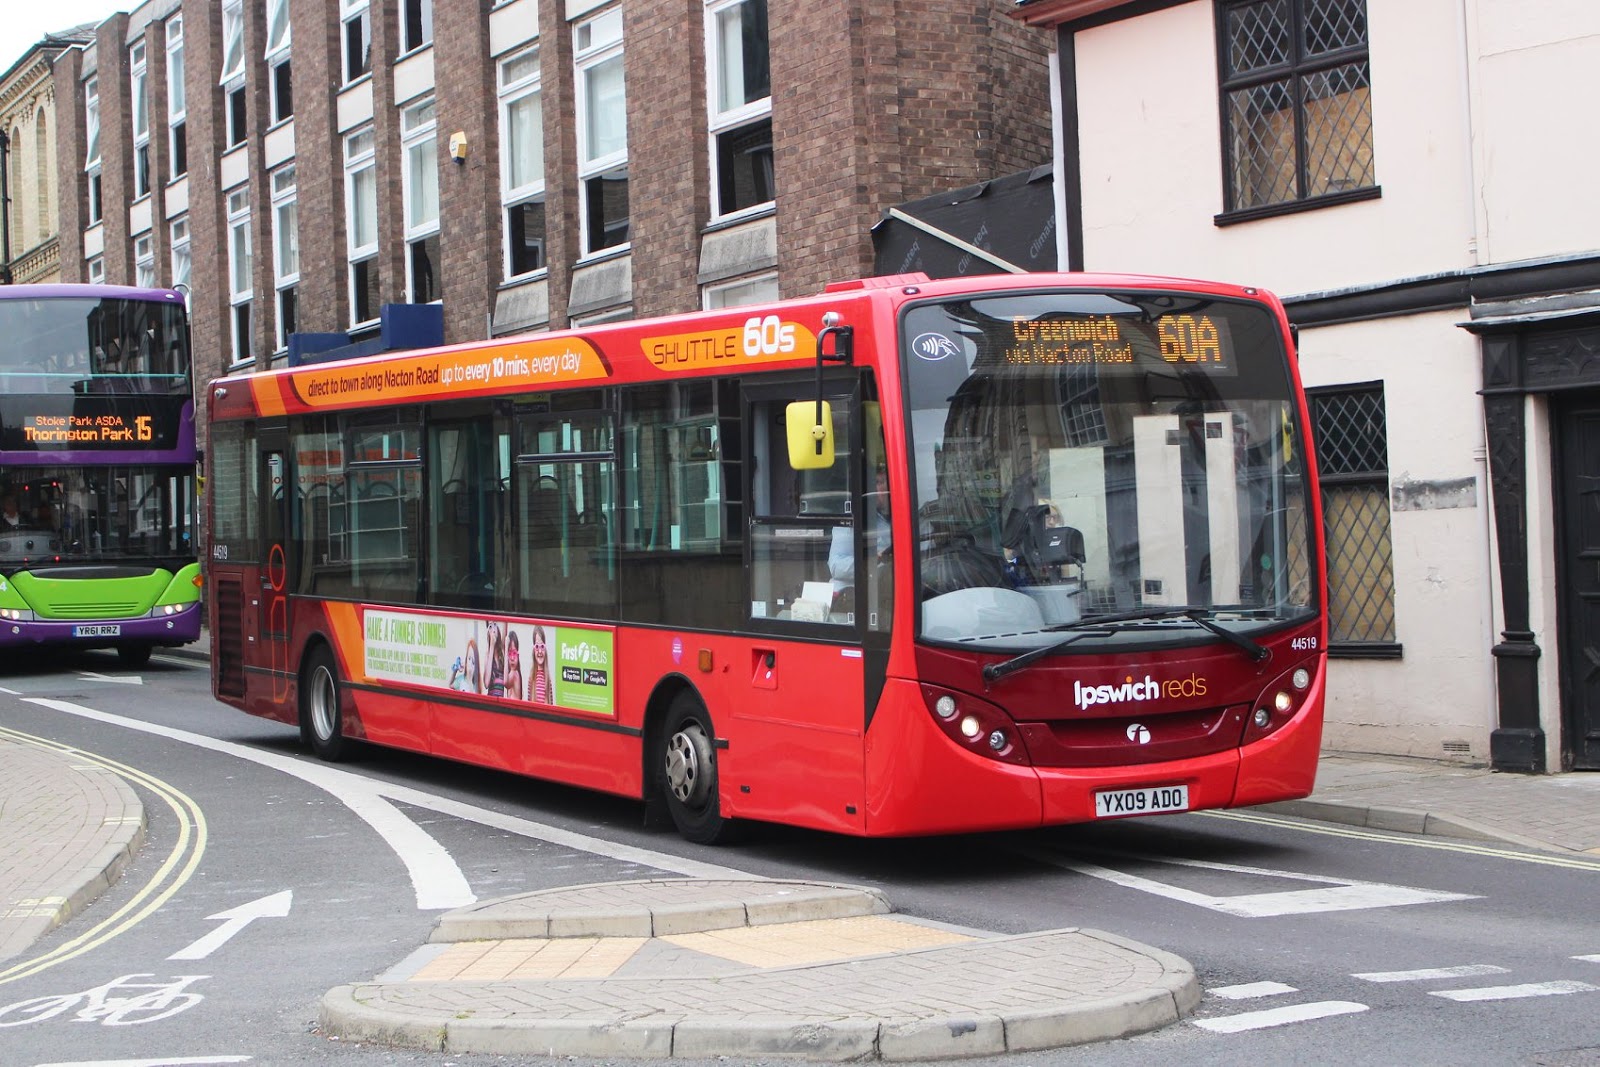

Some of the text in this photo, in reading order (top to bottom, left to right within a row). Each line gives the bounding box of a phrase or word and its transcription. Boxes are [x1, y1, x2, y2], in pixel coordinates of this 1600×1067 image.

[653, 314, 795, 364] SHUTTLE 60s
[1013, 315, 1221, 362] Greenwich 60A
[1005, 343, 1030, 363] via
[1092, 343, 1132, 362] Road
[308, 348, 582, 397] direct to town along Nacton Road up to every 10 mins, every day
[36, 416, 123, 426] Stoke Park ASDA
[135, 416, 152, 440] 15
[24, 427, 134, 441] Thorington Park
[79, 626, 118, 635] YR61 RRZ
[384, 618, 389, 641] A
[561, 642, 608, 664] First Bus
[1292, 637, 1317, 650] 44519
[1074, 673, 1207, 710] Ipswich reds
[1103, 789, 1181, 813] YX09 ADO
